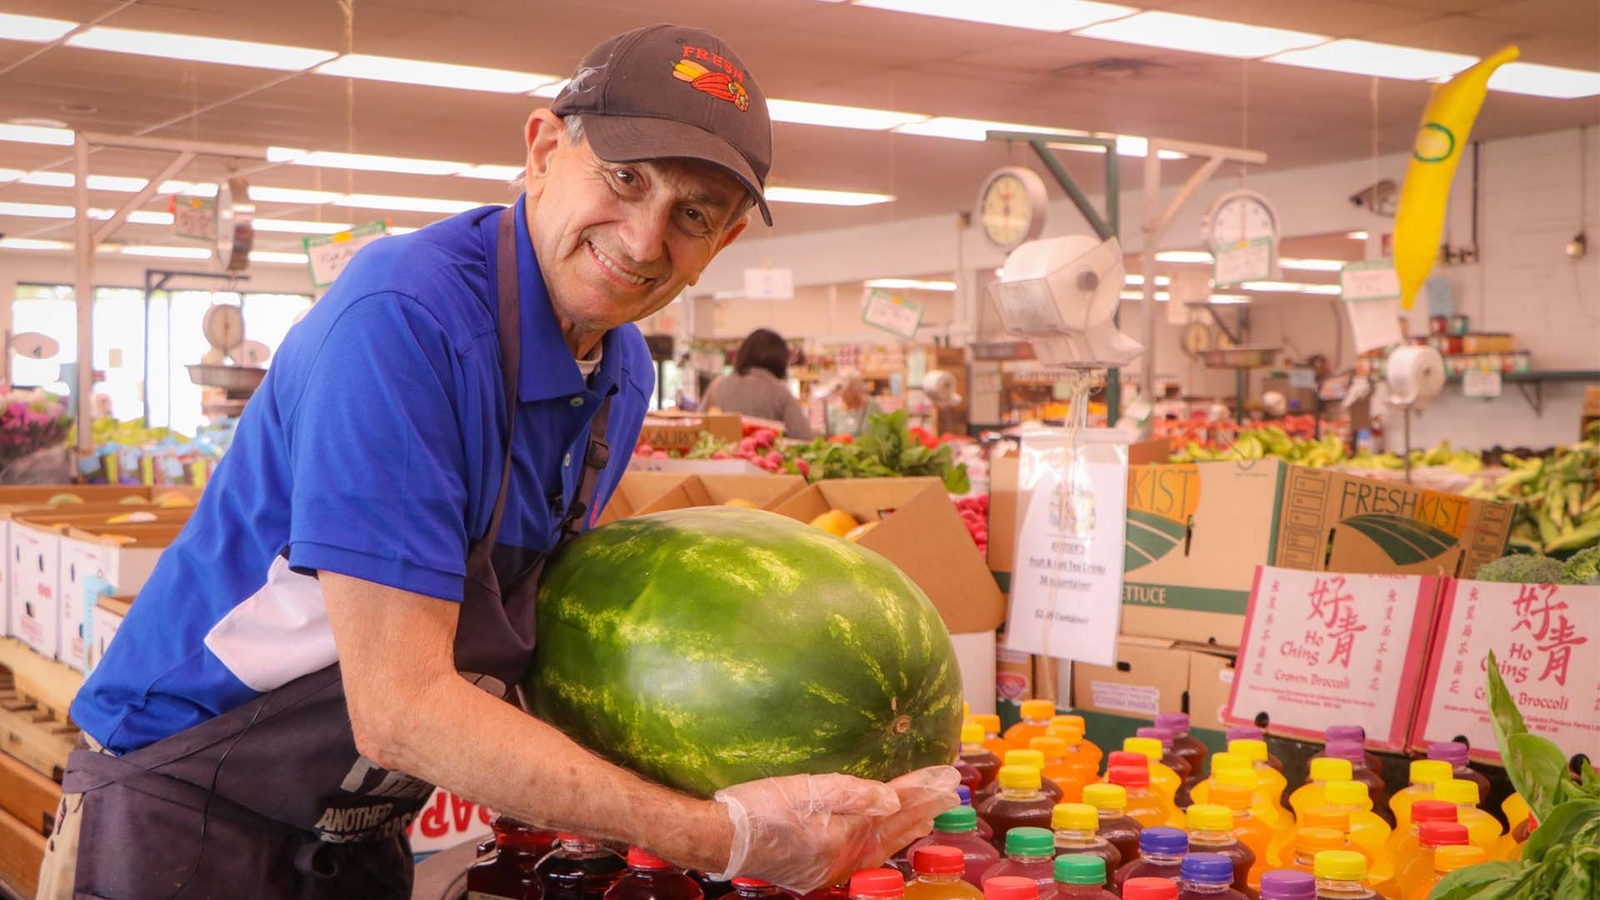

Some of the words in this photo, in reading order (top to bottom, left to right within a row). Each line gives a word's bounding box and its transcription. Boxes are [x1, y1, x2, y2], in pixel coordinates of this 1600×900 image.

[682, 44, 744, 84] FRESH
[1131, 468, 1200, 520] KIST
[1340, 480, 1469, 534] FRESHKIST
[1307, 576, 1367, 668] 好青
[1511, 583, 1587, 686] 好青
[1305, 629, 1324, 647] Ho
[1509, 643, 1532, 661] Ho
[1280, 640, 1320, 667] Ching
[1480, 656, 1530, 683] Cing
[1518, 692, 1569, 711] Broccoli
[314, 803, 393, 832] ANOTHER
